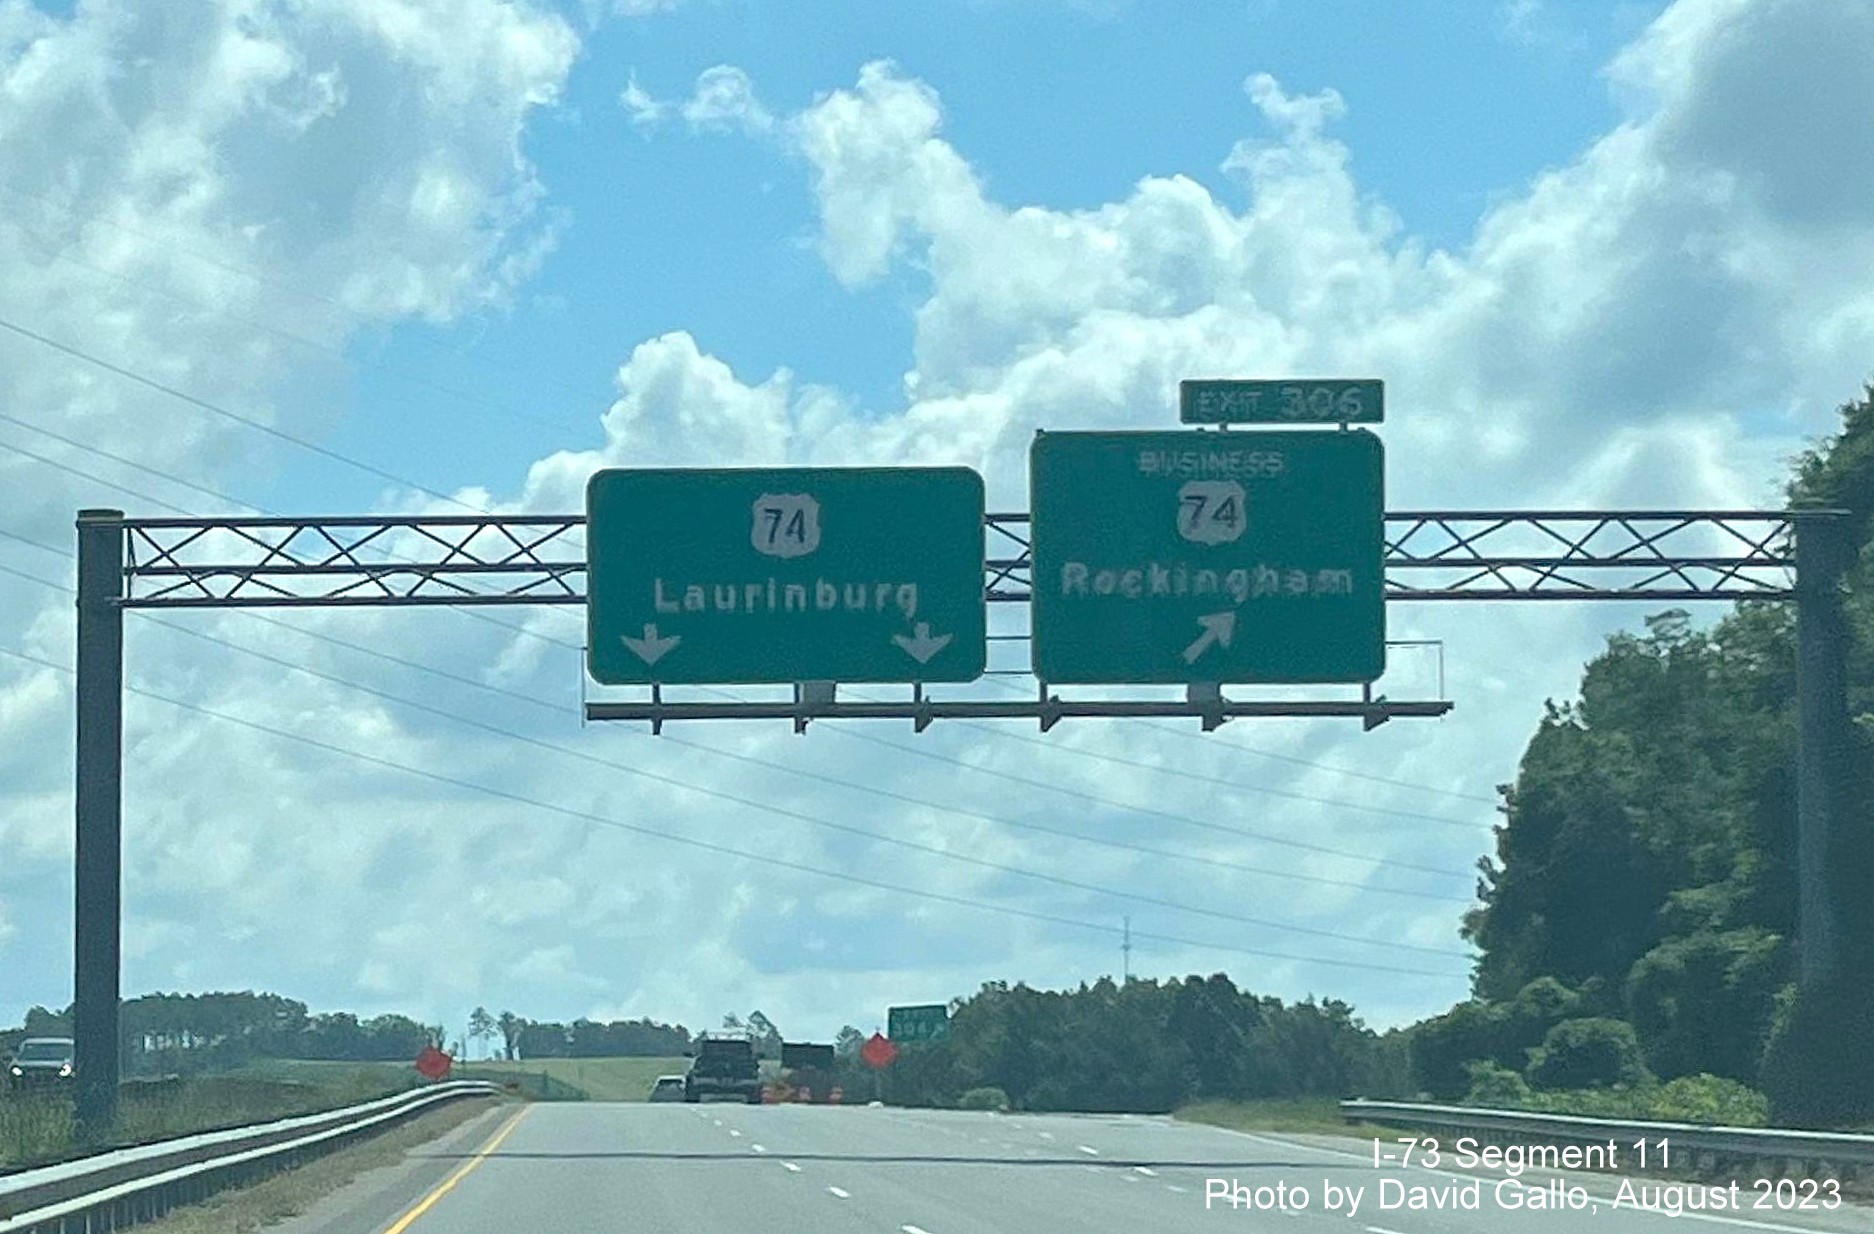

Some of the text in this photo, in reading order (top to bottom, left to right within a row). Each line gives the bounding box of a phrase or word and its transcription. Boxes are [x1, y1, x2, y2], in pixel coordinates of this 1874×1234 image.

[1197, 386, 1364, 419] EXIT 306
[1137, 450, 1285, 475] BUSINESS
[763, 507, 807, 545] 74
[1183, 494, 1239, 531] 74
[654, 576, 918, 619] Laurinburg
[1060, 561, 1353, 604] Rockingham
